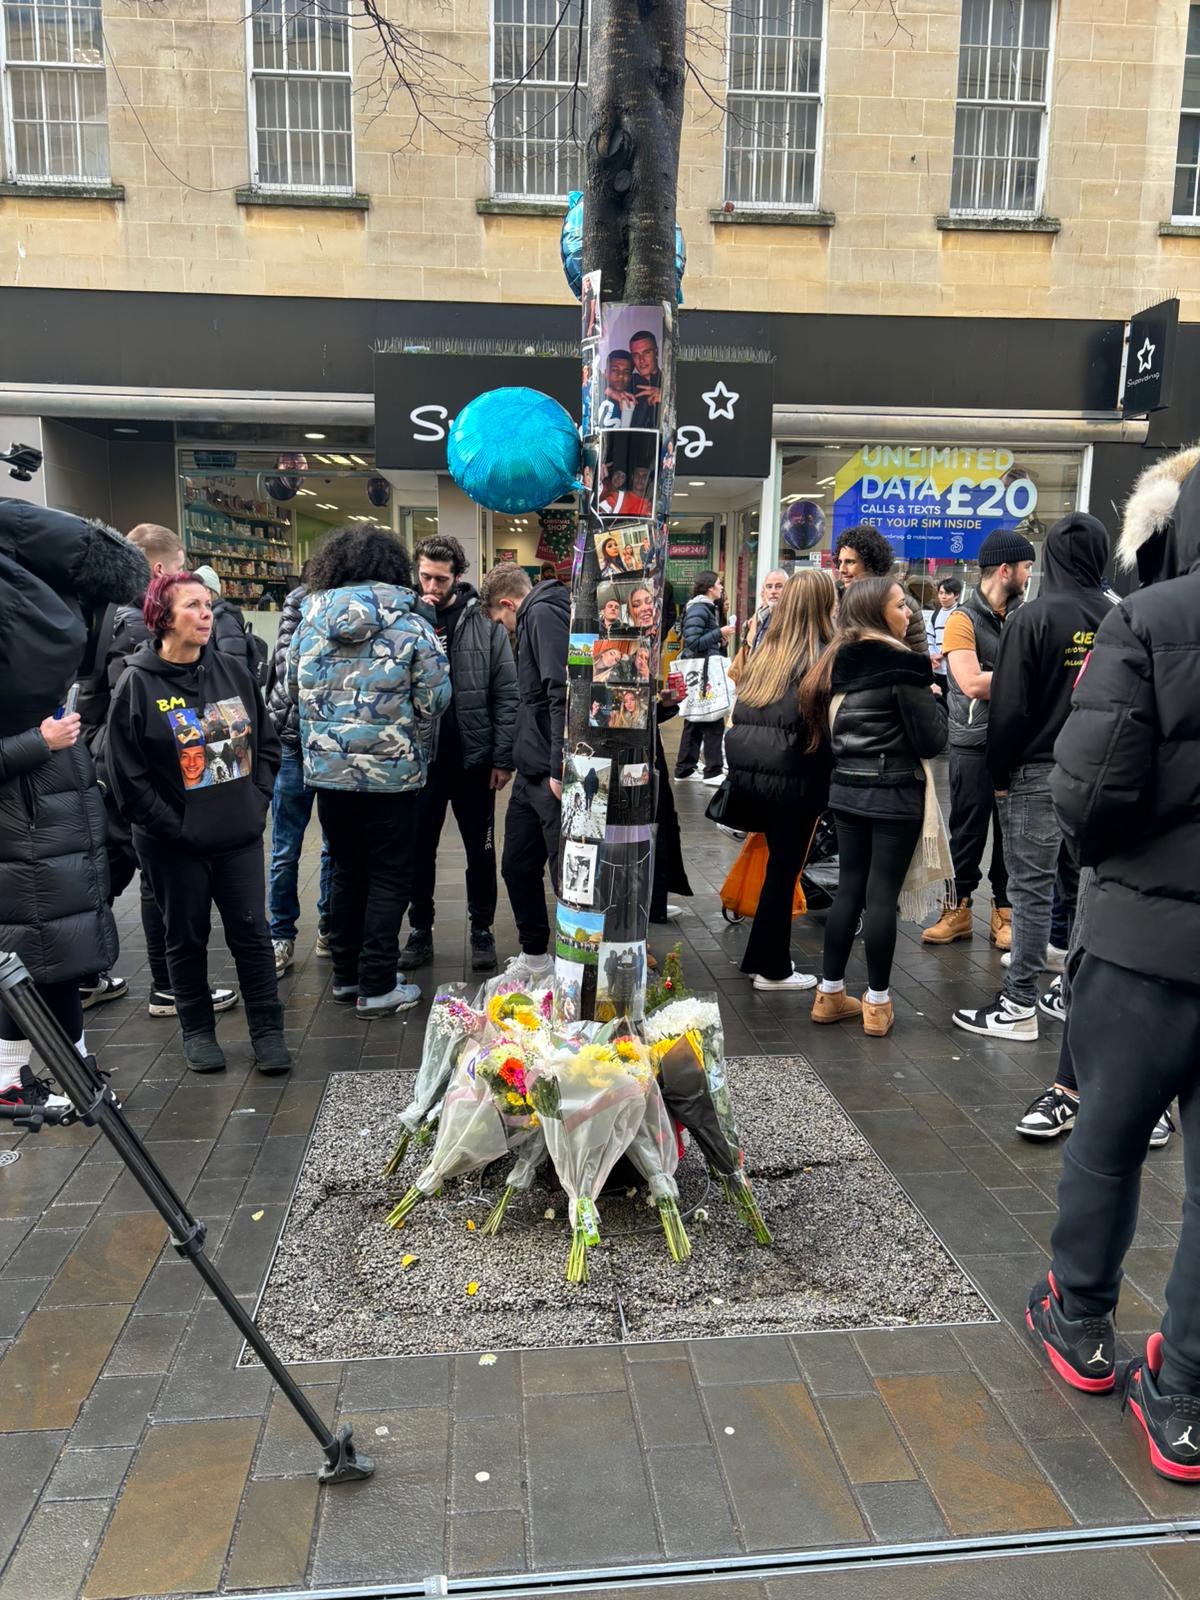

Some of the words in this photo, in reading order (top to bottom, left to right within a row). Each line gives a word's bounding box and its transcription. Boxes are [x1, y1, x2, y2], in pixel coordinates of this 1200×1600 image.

[863, 445, 1015, 471] UNLIMITED
[861, 474, 941, 501] DATA
[945, 476, 1038, 518] £20
[861, 503, 895, 515] CALLS
[897, 504, 906, 515] &
[908, 505, 941, 515] TEXTS
[860, 517, 882, 527] GET
[886, 518, 918, 528] YOUR
[921, 518, 941, 529] SIM
[944, 519, 982, 530] INSIDE
[156, 696, 185, 716] BM
